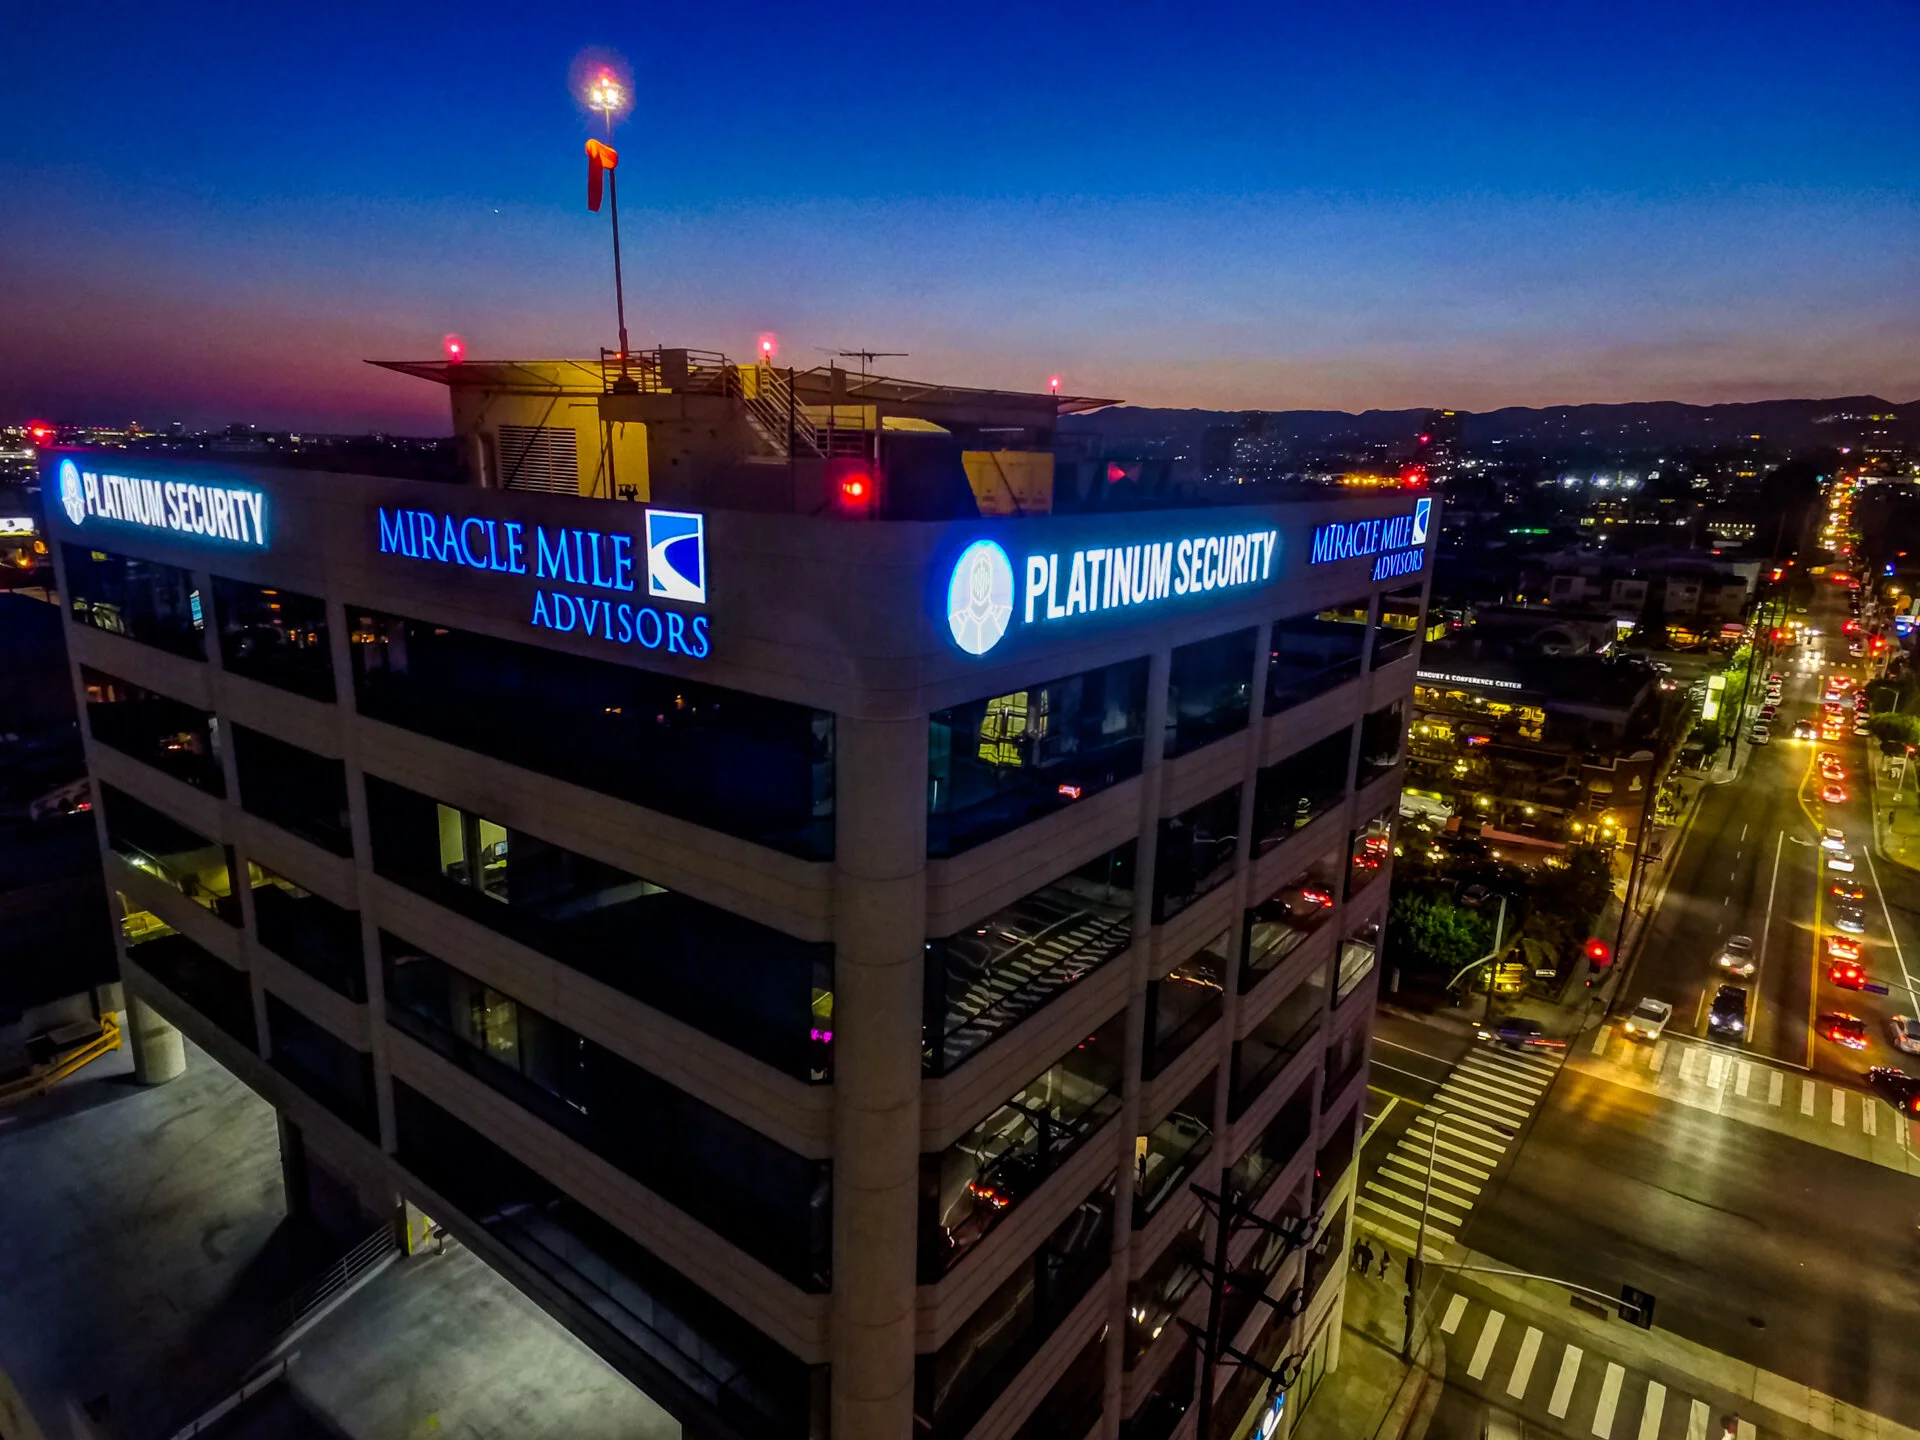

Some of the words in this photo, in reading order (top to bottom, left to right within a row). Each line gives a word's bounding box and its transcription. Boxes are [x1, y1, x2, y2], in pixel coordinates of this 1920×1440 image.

[82, 472, 167, 528] PLATINUM
[164, 481, 263, 545] SECURITY
[1311, 520, 1381, 564] MIRACLE
[1380, 516, 1412, 551] MILE
[379, 507, 526, 575] MIRACLE
[536, 526, 635, 592] MILE
[1024, 541, 1173, 623] PLATINUM
[1173, 530, 1277, 595] SECURITY
[1372, 548, 1425, 581] ADVISORS
[531, 589, 709, 659] ADVISORS
[1451, 675, 1494, 686] CONFERENCE
[1495, 680, 1522, 689] CENTER
